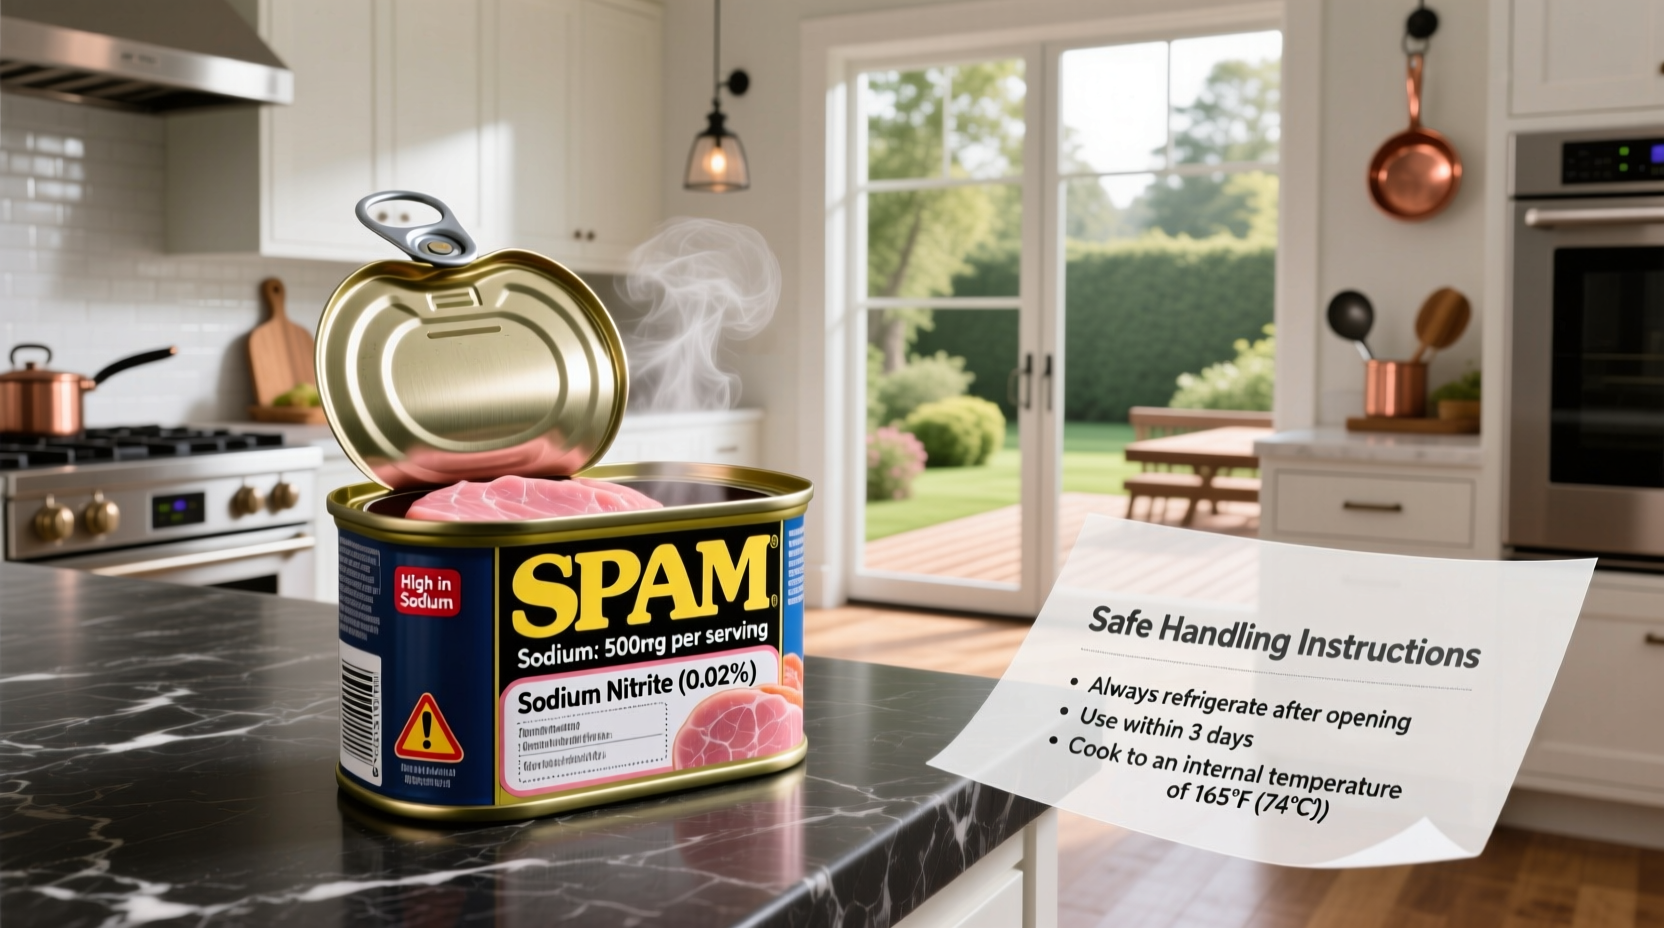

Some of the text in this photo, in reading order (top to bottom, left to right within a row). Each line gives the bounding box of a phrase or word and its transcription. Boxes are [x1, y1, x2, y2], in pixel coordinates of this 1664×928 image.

[401, 592, 453, 609] Sodium
[438, 577, 451, 590] in
[511, 535, 769, 639] SPAM
[518, 644, 598, 668] Sodium:
[672, 632, 701, 653] per
[706, 621, 767, 643] serving
[1089, 606, 1481, 668] Safe Handling Instructions
[518, 660, 756, 714] Sodium Nitrite (0.02%)
[1088, 676, 1411, 735] Always refrigerate after opening
[1081, 707, 1254, 749] Use within 3 days
[1069, 736, 1402, 799] Cook to an internal temperature
[1167, 783, 1191, 799] of
